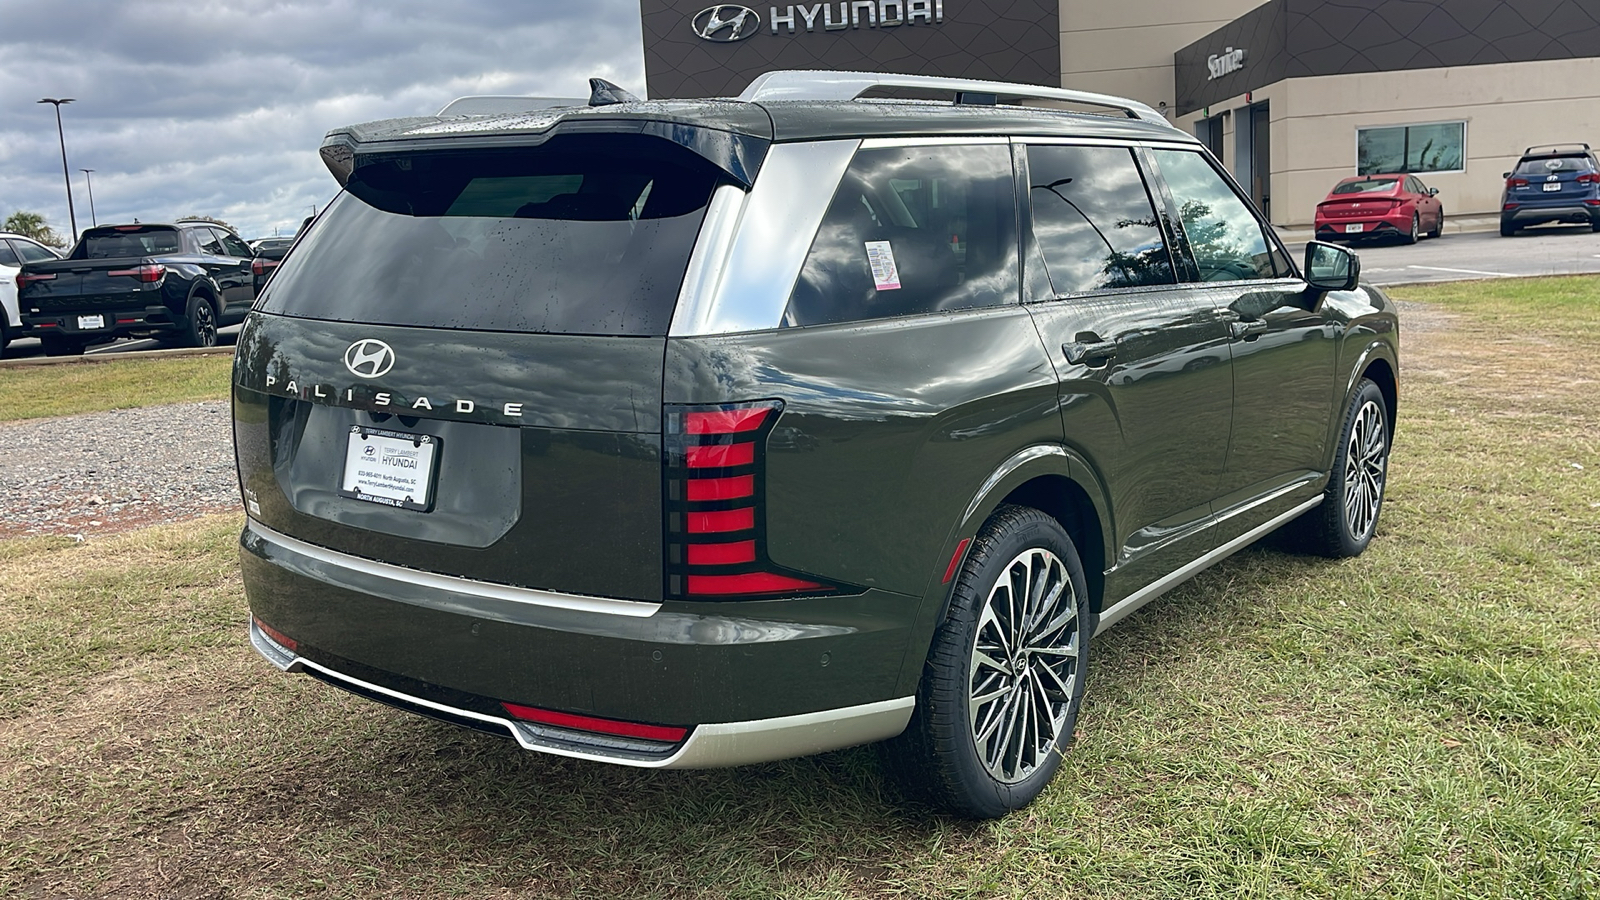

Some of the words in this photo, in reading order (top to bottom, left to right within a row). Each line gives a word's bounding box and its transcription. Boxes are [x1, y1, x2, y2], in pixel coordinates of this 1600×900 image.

[770, 0, 943, 34] HYUNDAI
[266, 376, 524, 417] PALISADE
[378, 430, 396, 438] LAMBERT
[396, 432, 415, 440] HYUNDAI
[397, 448, 419, 457] LAMBERT
[381, 456, 418, 470] HYUNDAI
